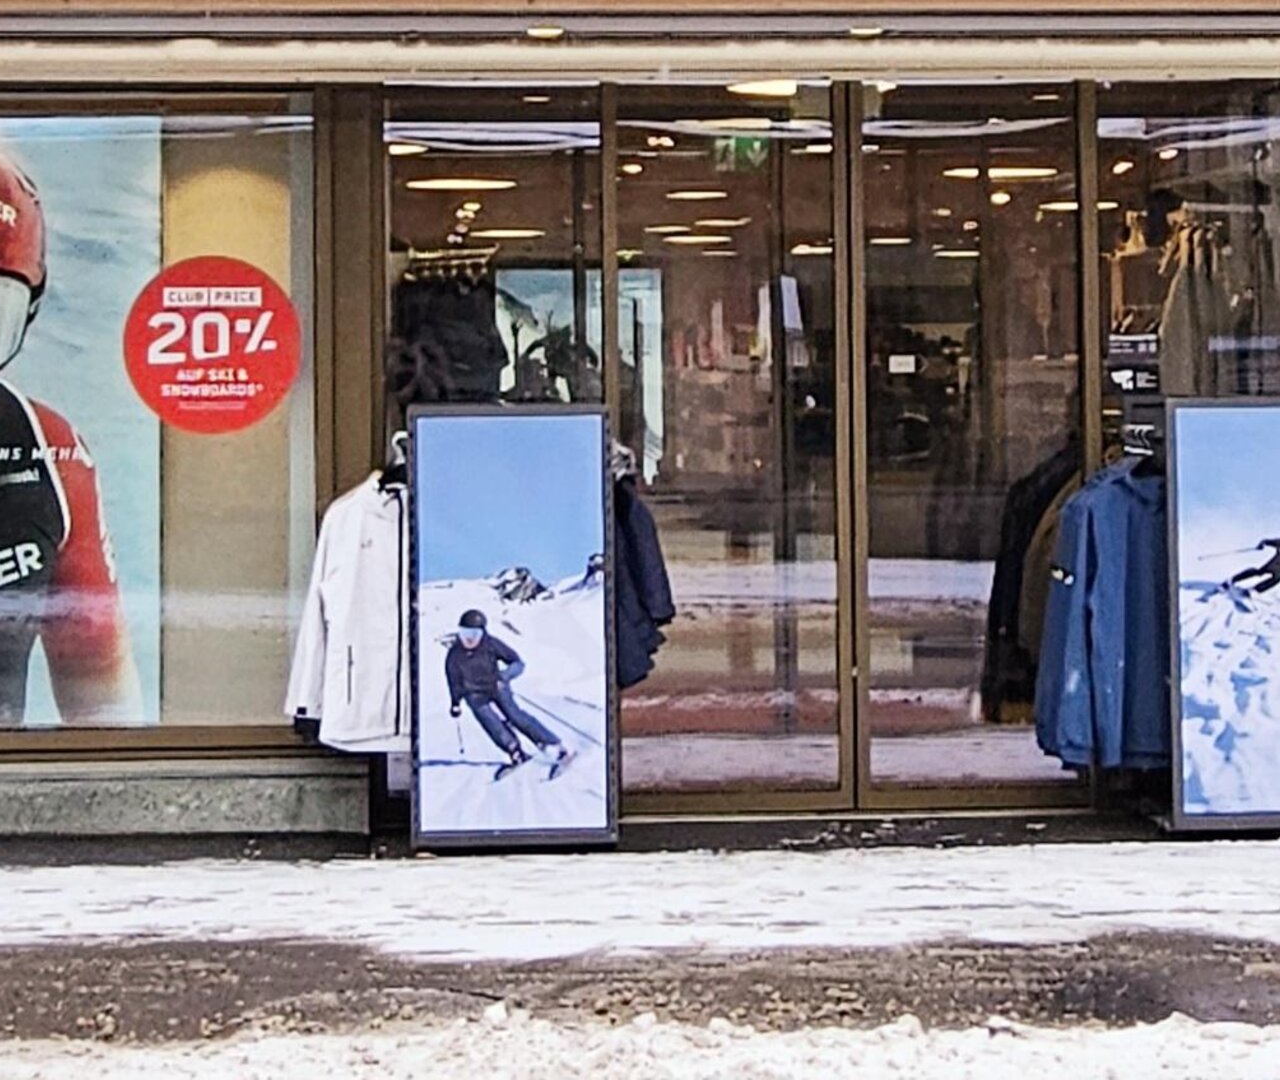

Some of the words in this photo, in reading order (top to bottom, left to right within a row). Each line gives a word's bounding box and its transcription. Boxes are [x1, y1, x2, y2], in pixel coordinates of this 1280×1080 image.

[167, 291, 204, 303] CLUB
[214, 291, 257, 303] PRICE
[147, 310, 278, 365] 20%
